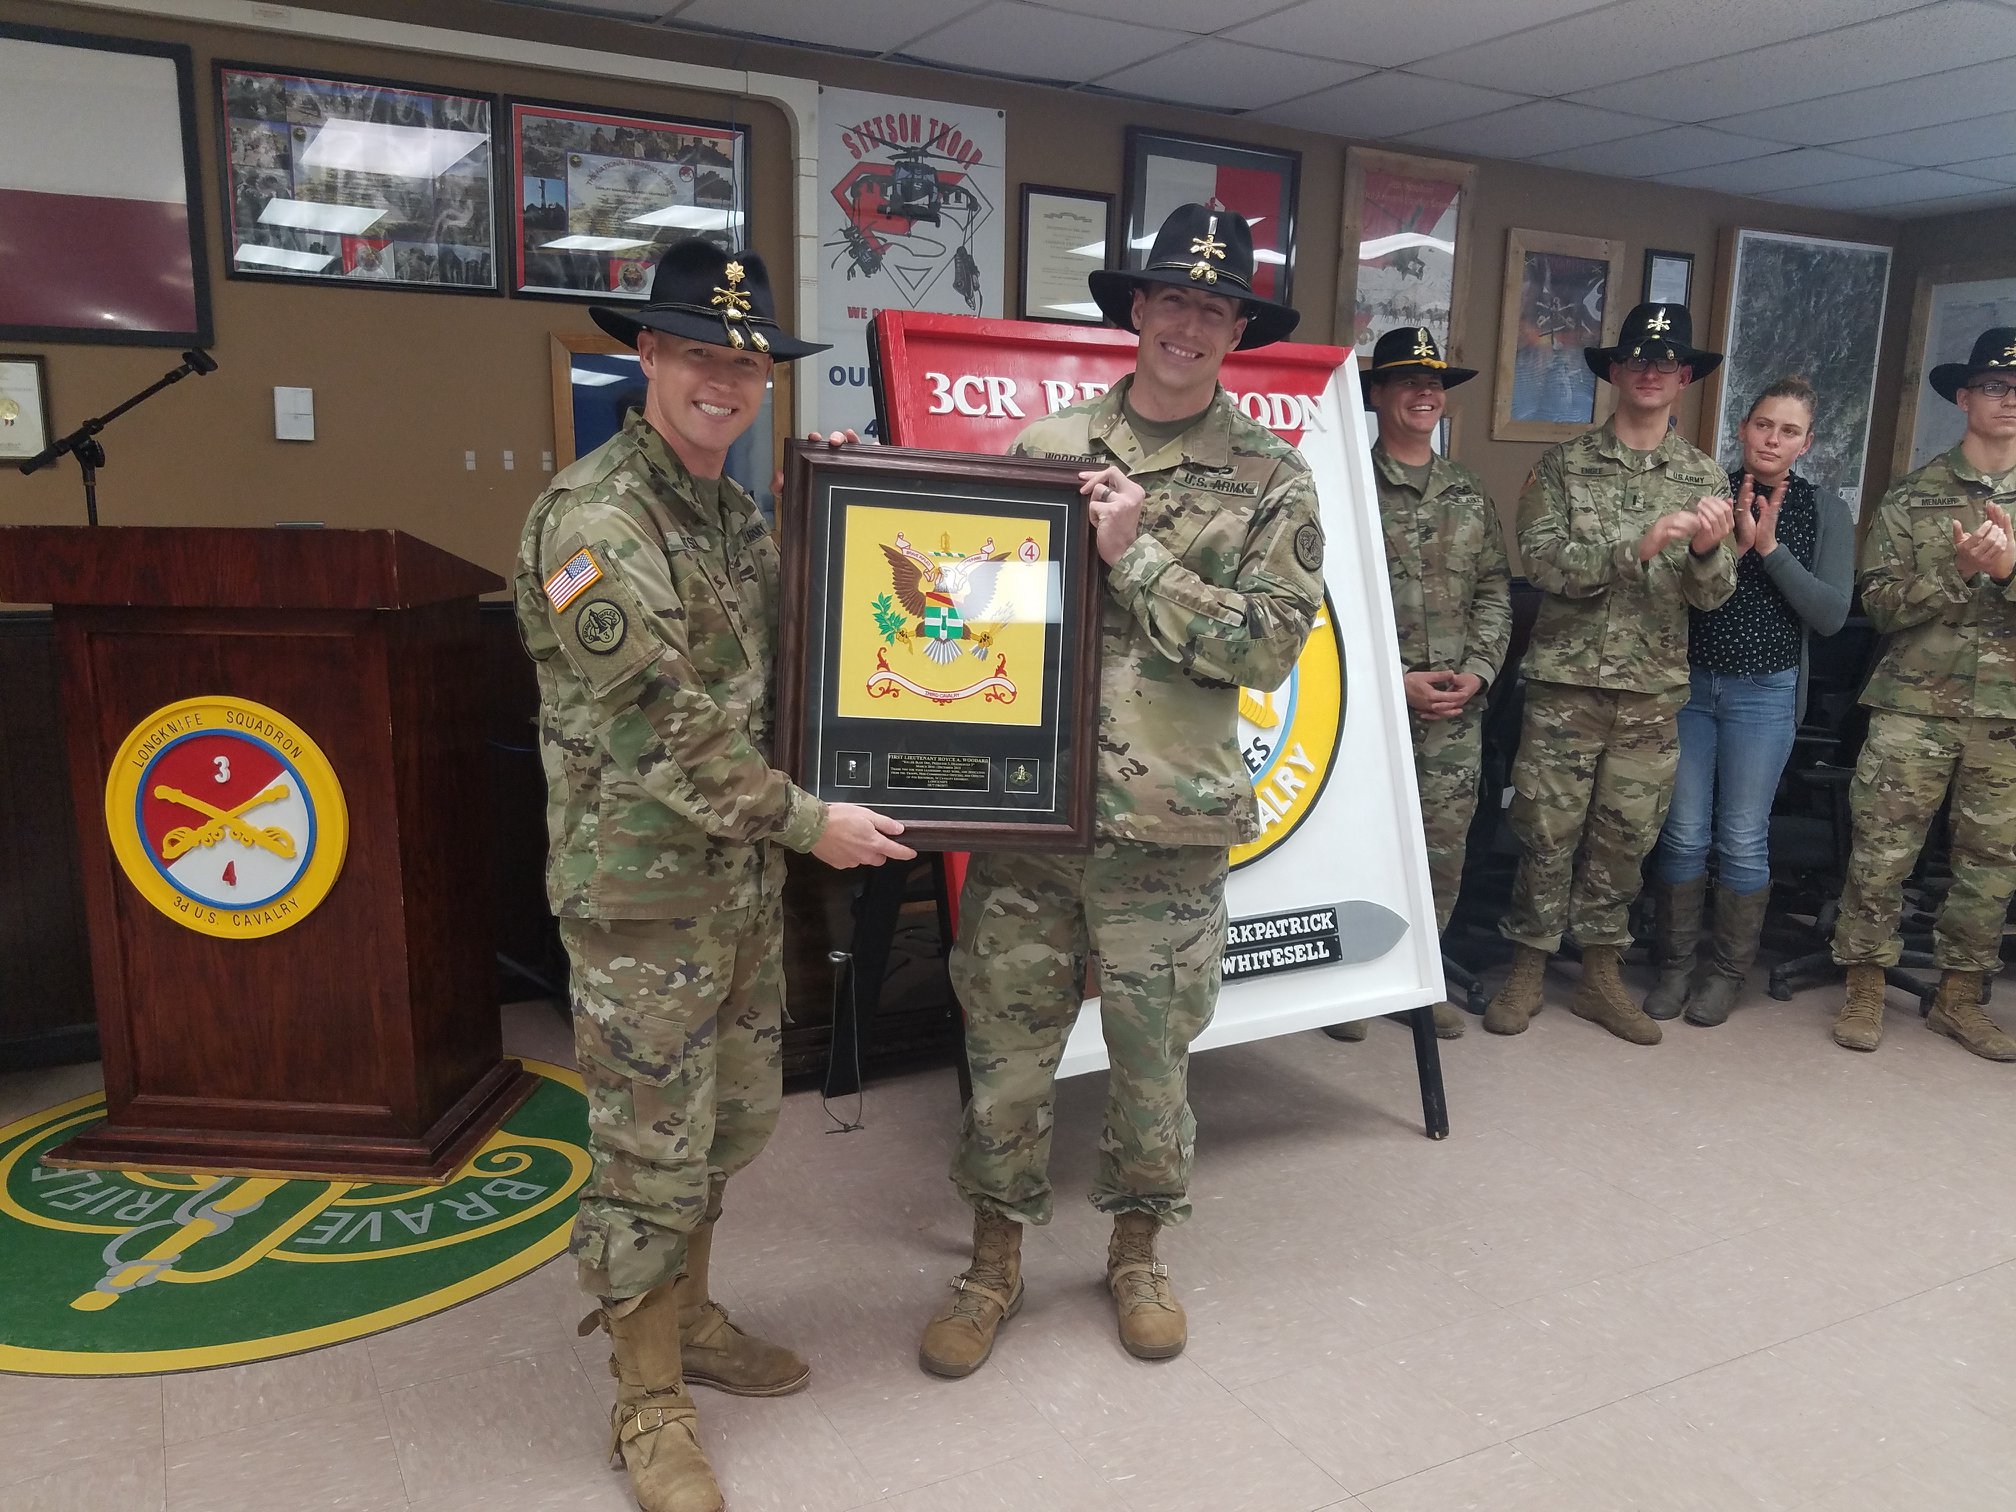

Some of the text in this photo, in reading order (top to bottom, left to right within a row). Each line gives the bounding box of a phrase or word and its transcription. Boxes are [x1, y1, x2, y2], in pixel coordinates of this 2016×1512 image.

[842, 113, 983, 170] STETSON TROOP
[847, 306, 868, 319] WE
[829, 366, 873, 387] OU
[925, 372, 1026, 419] 3CR
[1184, 473, 1249, 494] U.S. ARMY
[1025, 545, 1035, 560] 4
[132, 711, 302, 768] LONGKNIFE SQUADRON
[213, 755, 231, 783] 3
[1259, 742, 1316, 833] ALRY
[221, 860, 237, 886] 4
[173, 896, 299, 926] 3d U.S. CAVALRY
[1226, 911, 1335, 945] RKPATRICK
[1222, 941, 1330, 974] WHITESELL
[294, 1177, 548, 1245] BRAVE
